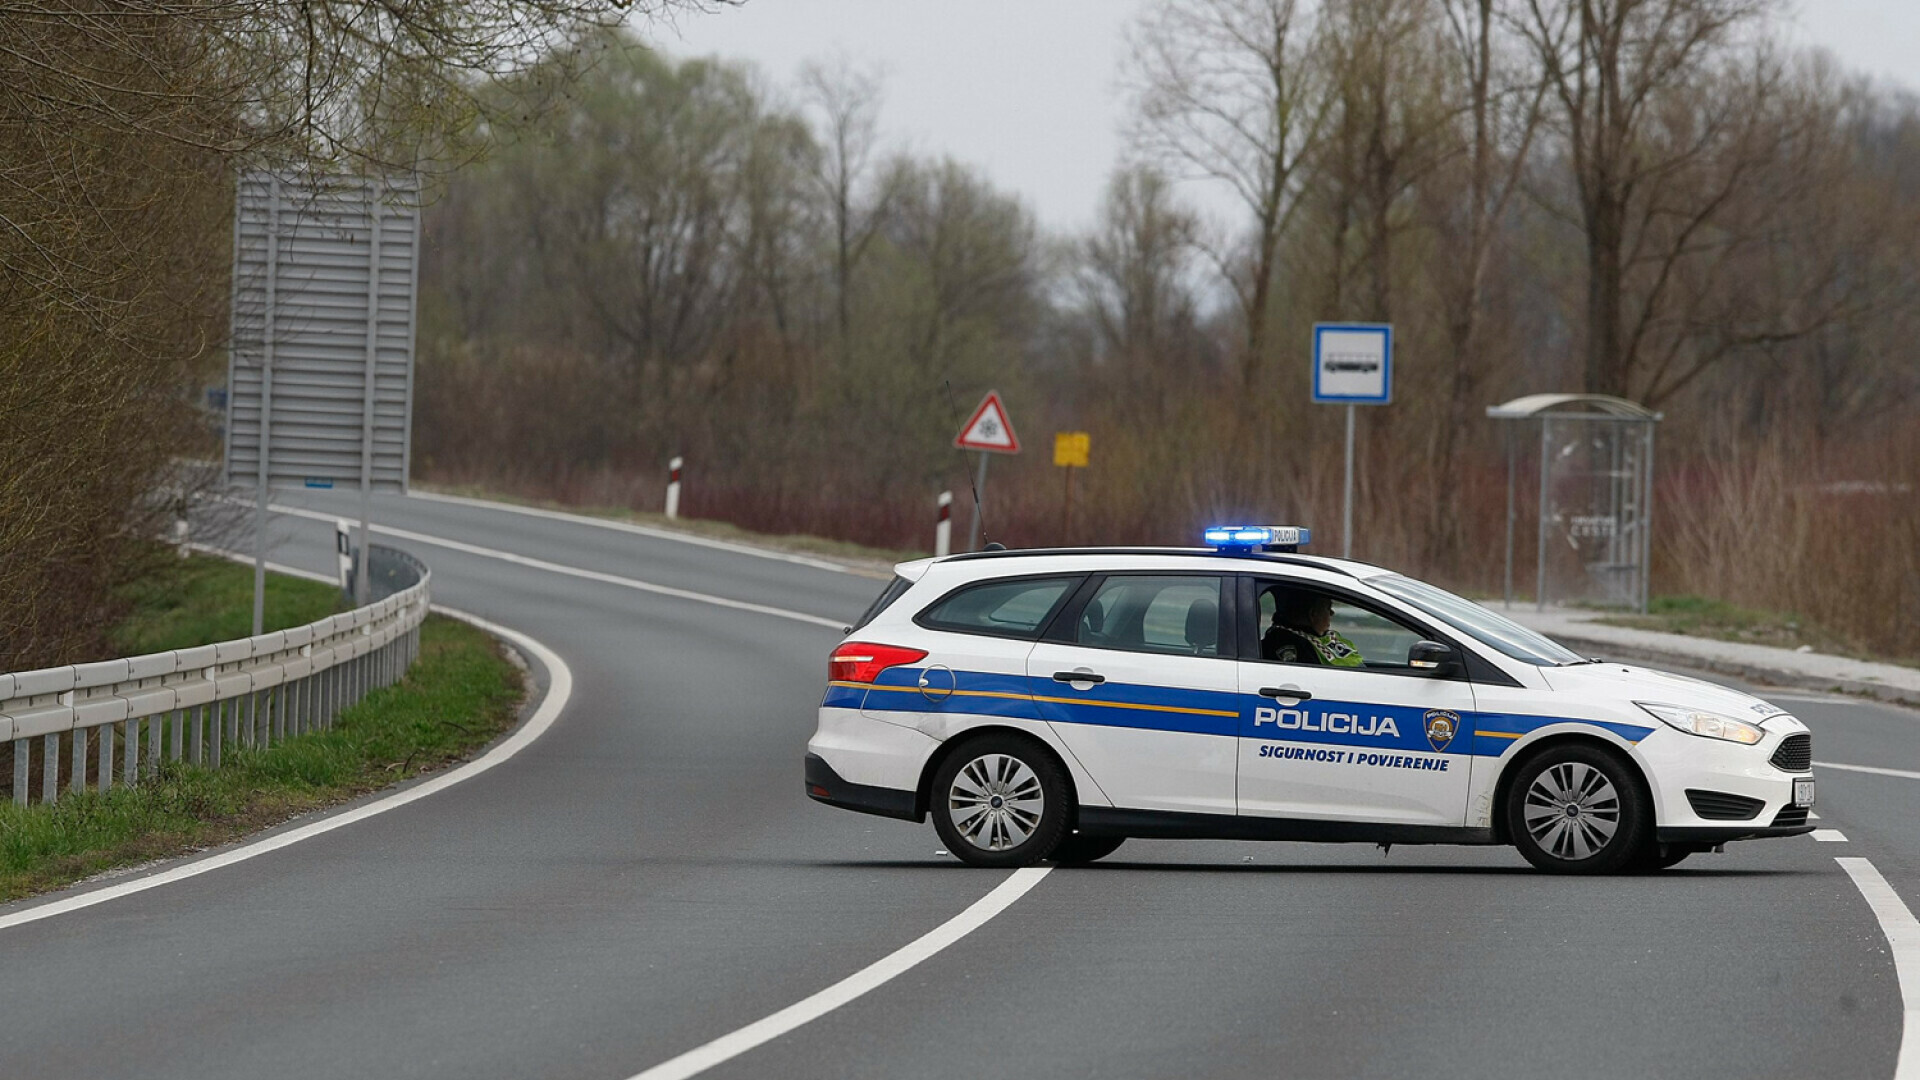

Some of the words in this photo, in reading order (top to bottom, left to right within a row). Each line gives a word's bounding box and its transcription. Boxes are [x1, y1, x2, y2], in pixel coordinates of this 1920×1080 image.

[1274, 529, 1296, 542] POLICIJA
[1254, 706, 1400, 737] POLICIJA
[1426, 711, 1458, 721] POLICIJA
[1259, 745, 1345, 763] SIGURNOST
[1347, 752, 1354, 764] I
[1356, 753, 1450, 772] POVJERENJE
